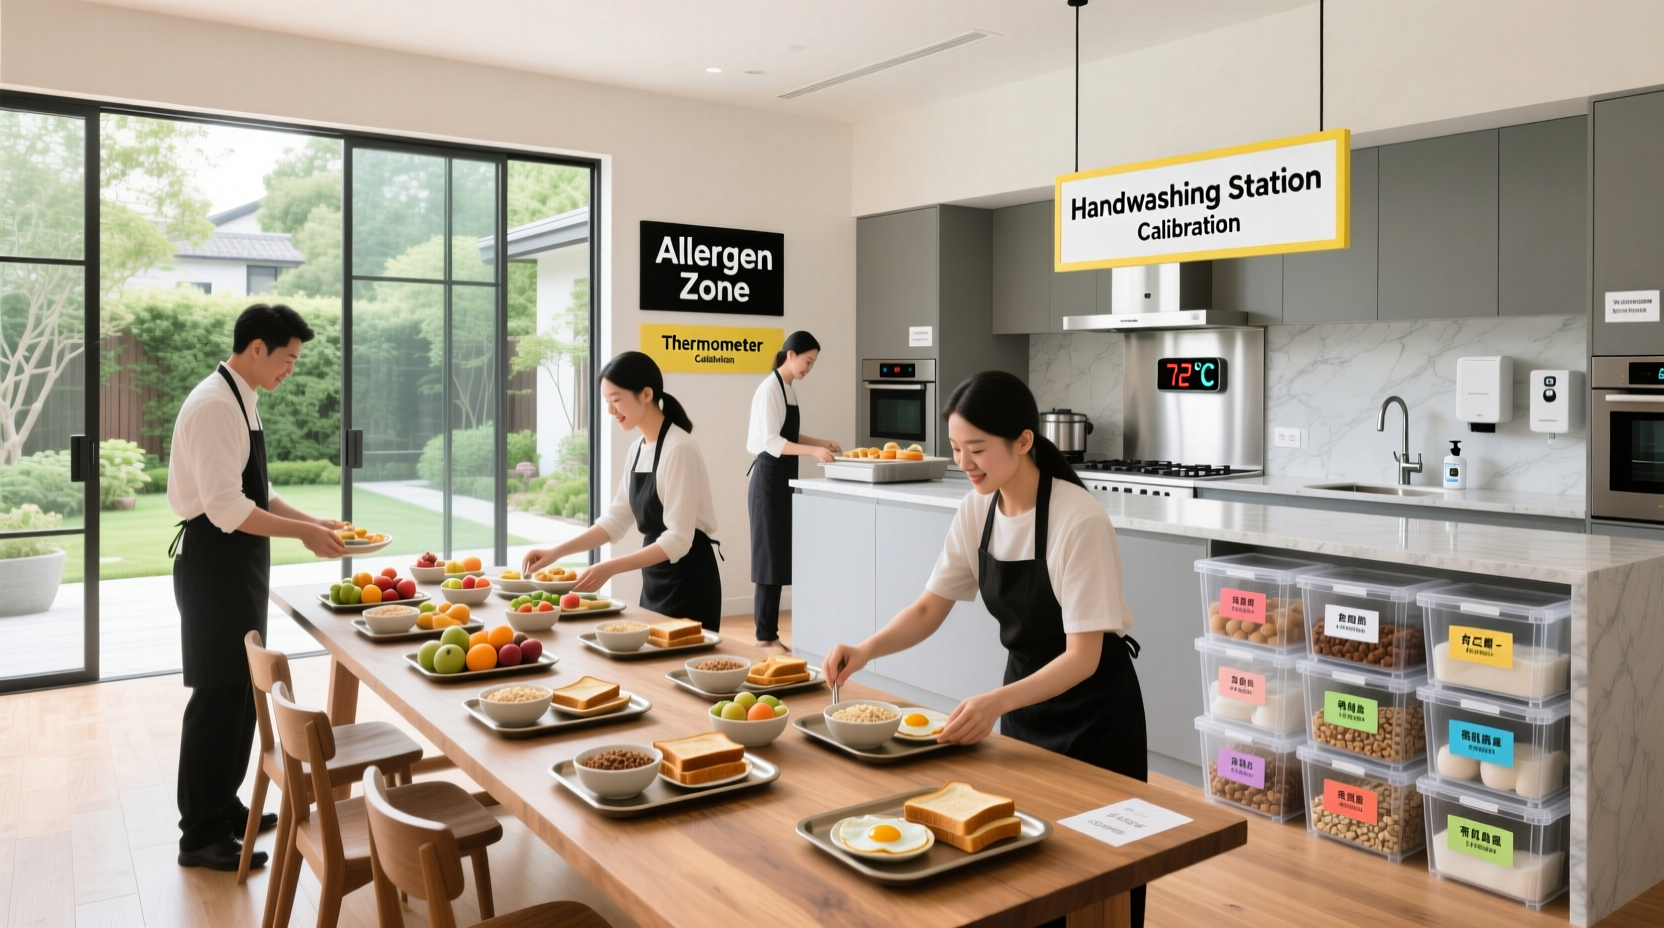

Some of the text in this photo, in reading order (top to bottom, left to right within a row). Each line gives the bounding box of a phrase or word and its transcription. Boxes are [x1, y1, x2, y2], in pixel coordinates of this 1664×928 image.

[1071, 166, 1322, 220] Handwashing Station
[1137, 214, 1241, 241] Calibration
[655, 236, 773, 276] Allergen
[679, 271, 750, 303] Zone
[661, 334, 764, 353] Thermometer
